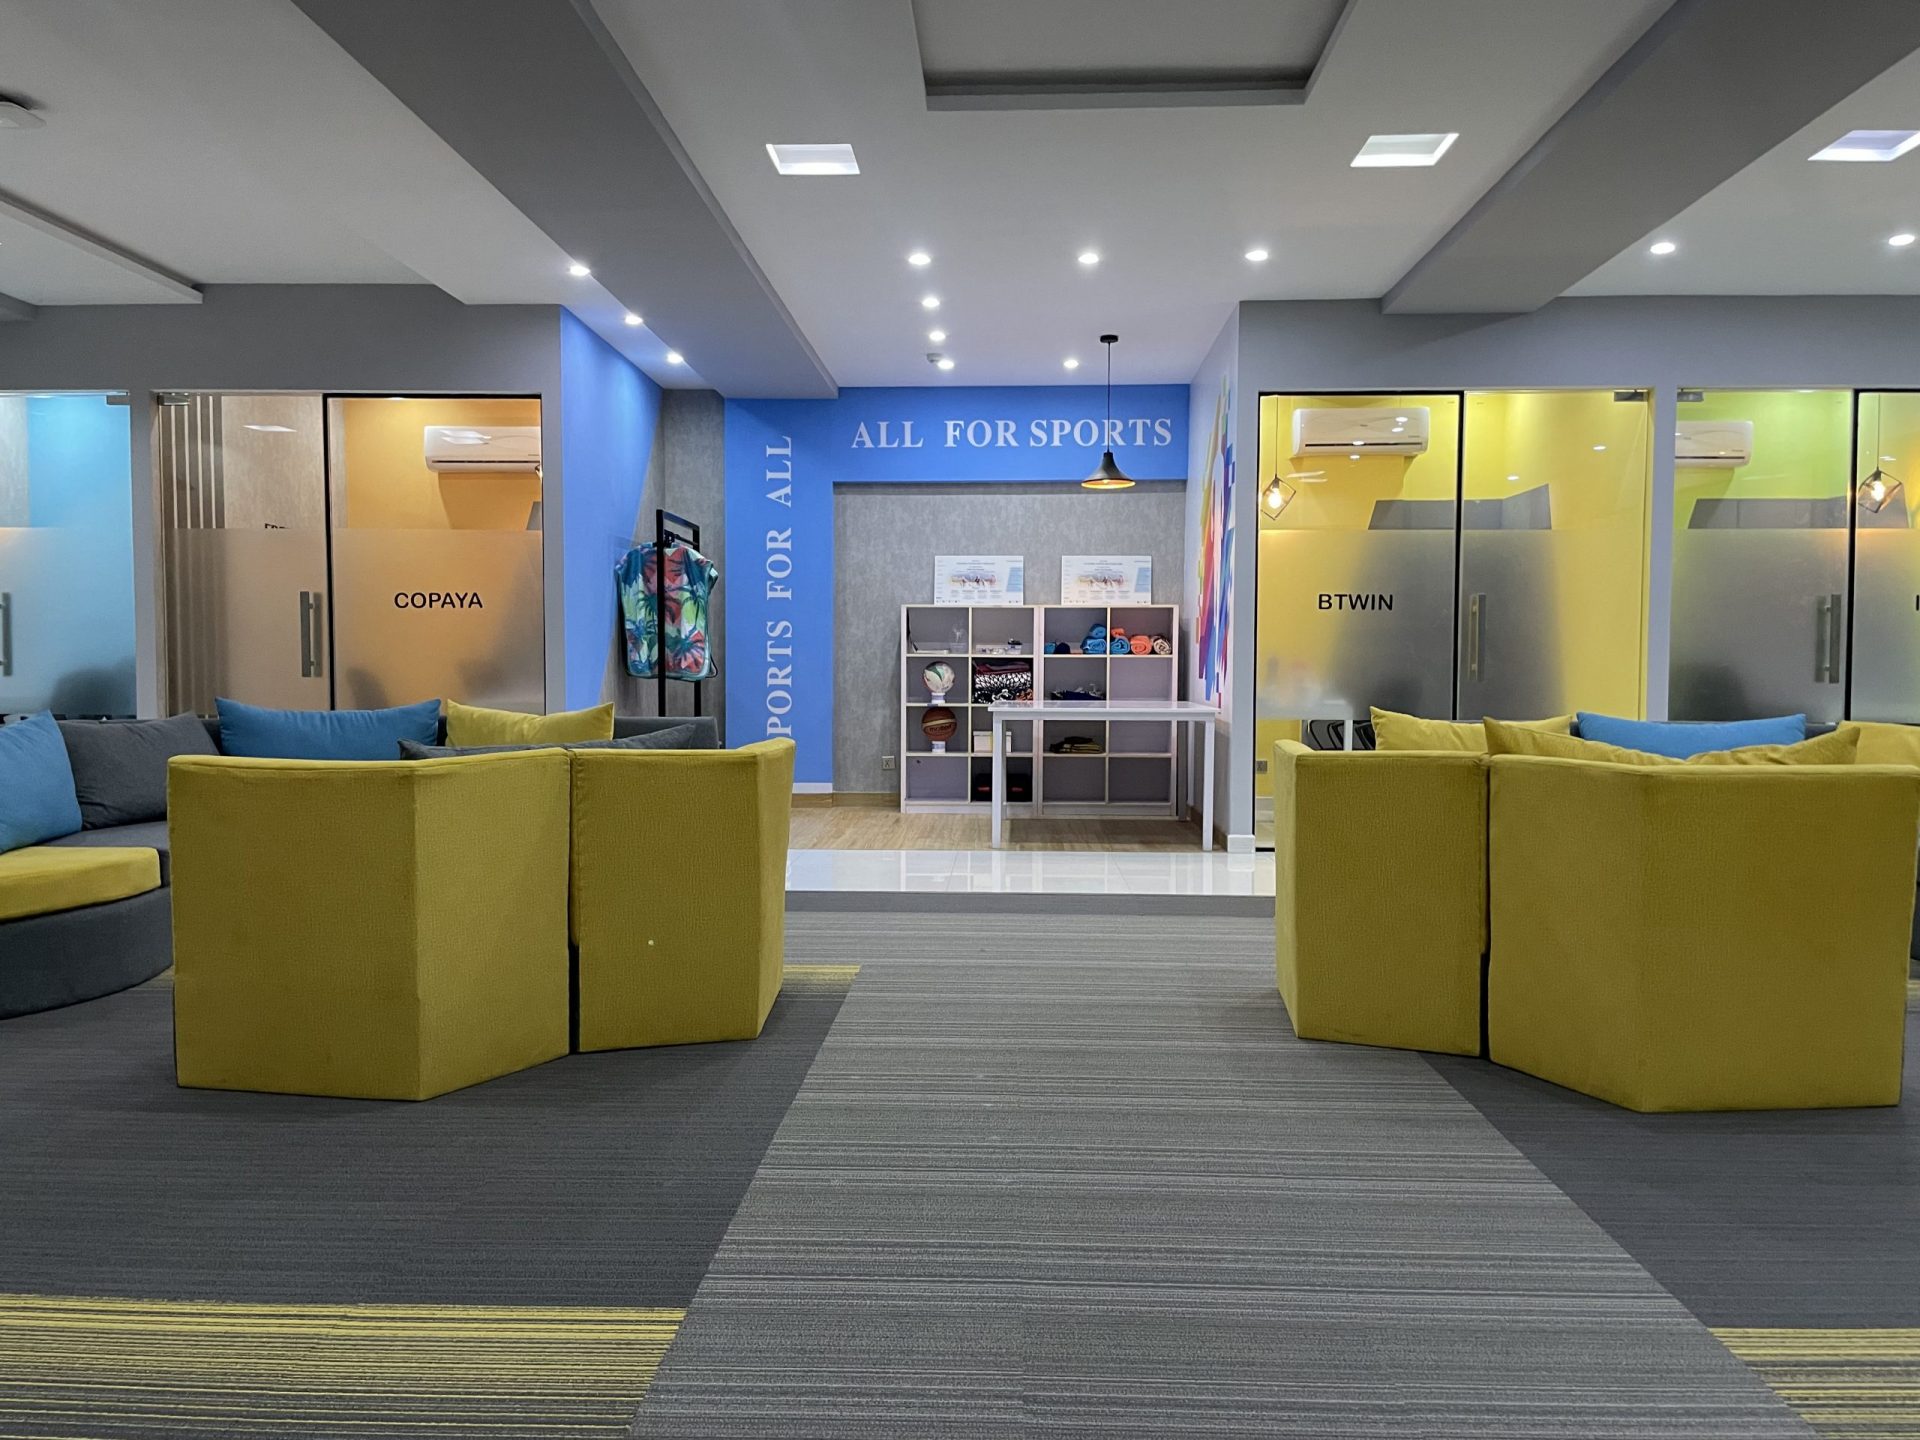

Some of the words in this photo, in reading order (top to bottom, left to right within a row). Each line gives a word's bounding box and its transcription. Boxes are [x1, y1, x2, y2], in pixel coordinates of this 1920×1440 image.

[852, 421, 924, 448] ALL
[944, 420, 1019, 448] FOR
[1029, 418, 1172, 447] SPORTS
[766, 435, 792, 508] ALL
[766, 527, 792, 601] FOR
[394, 592, 484, 609] COPAYA
[1317, 593, 1394, 611] BTWIN
[766, 620, 792, 737] PORTS
